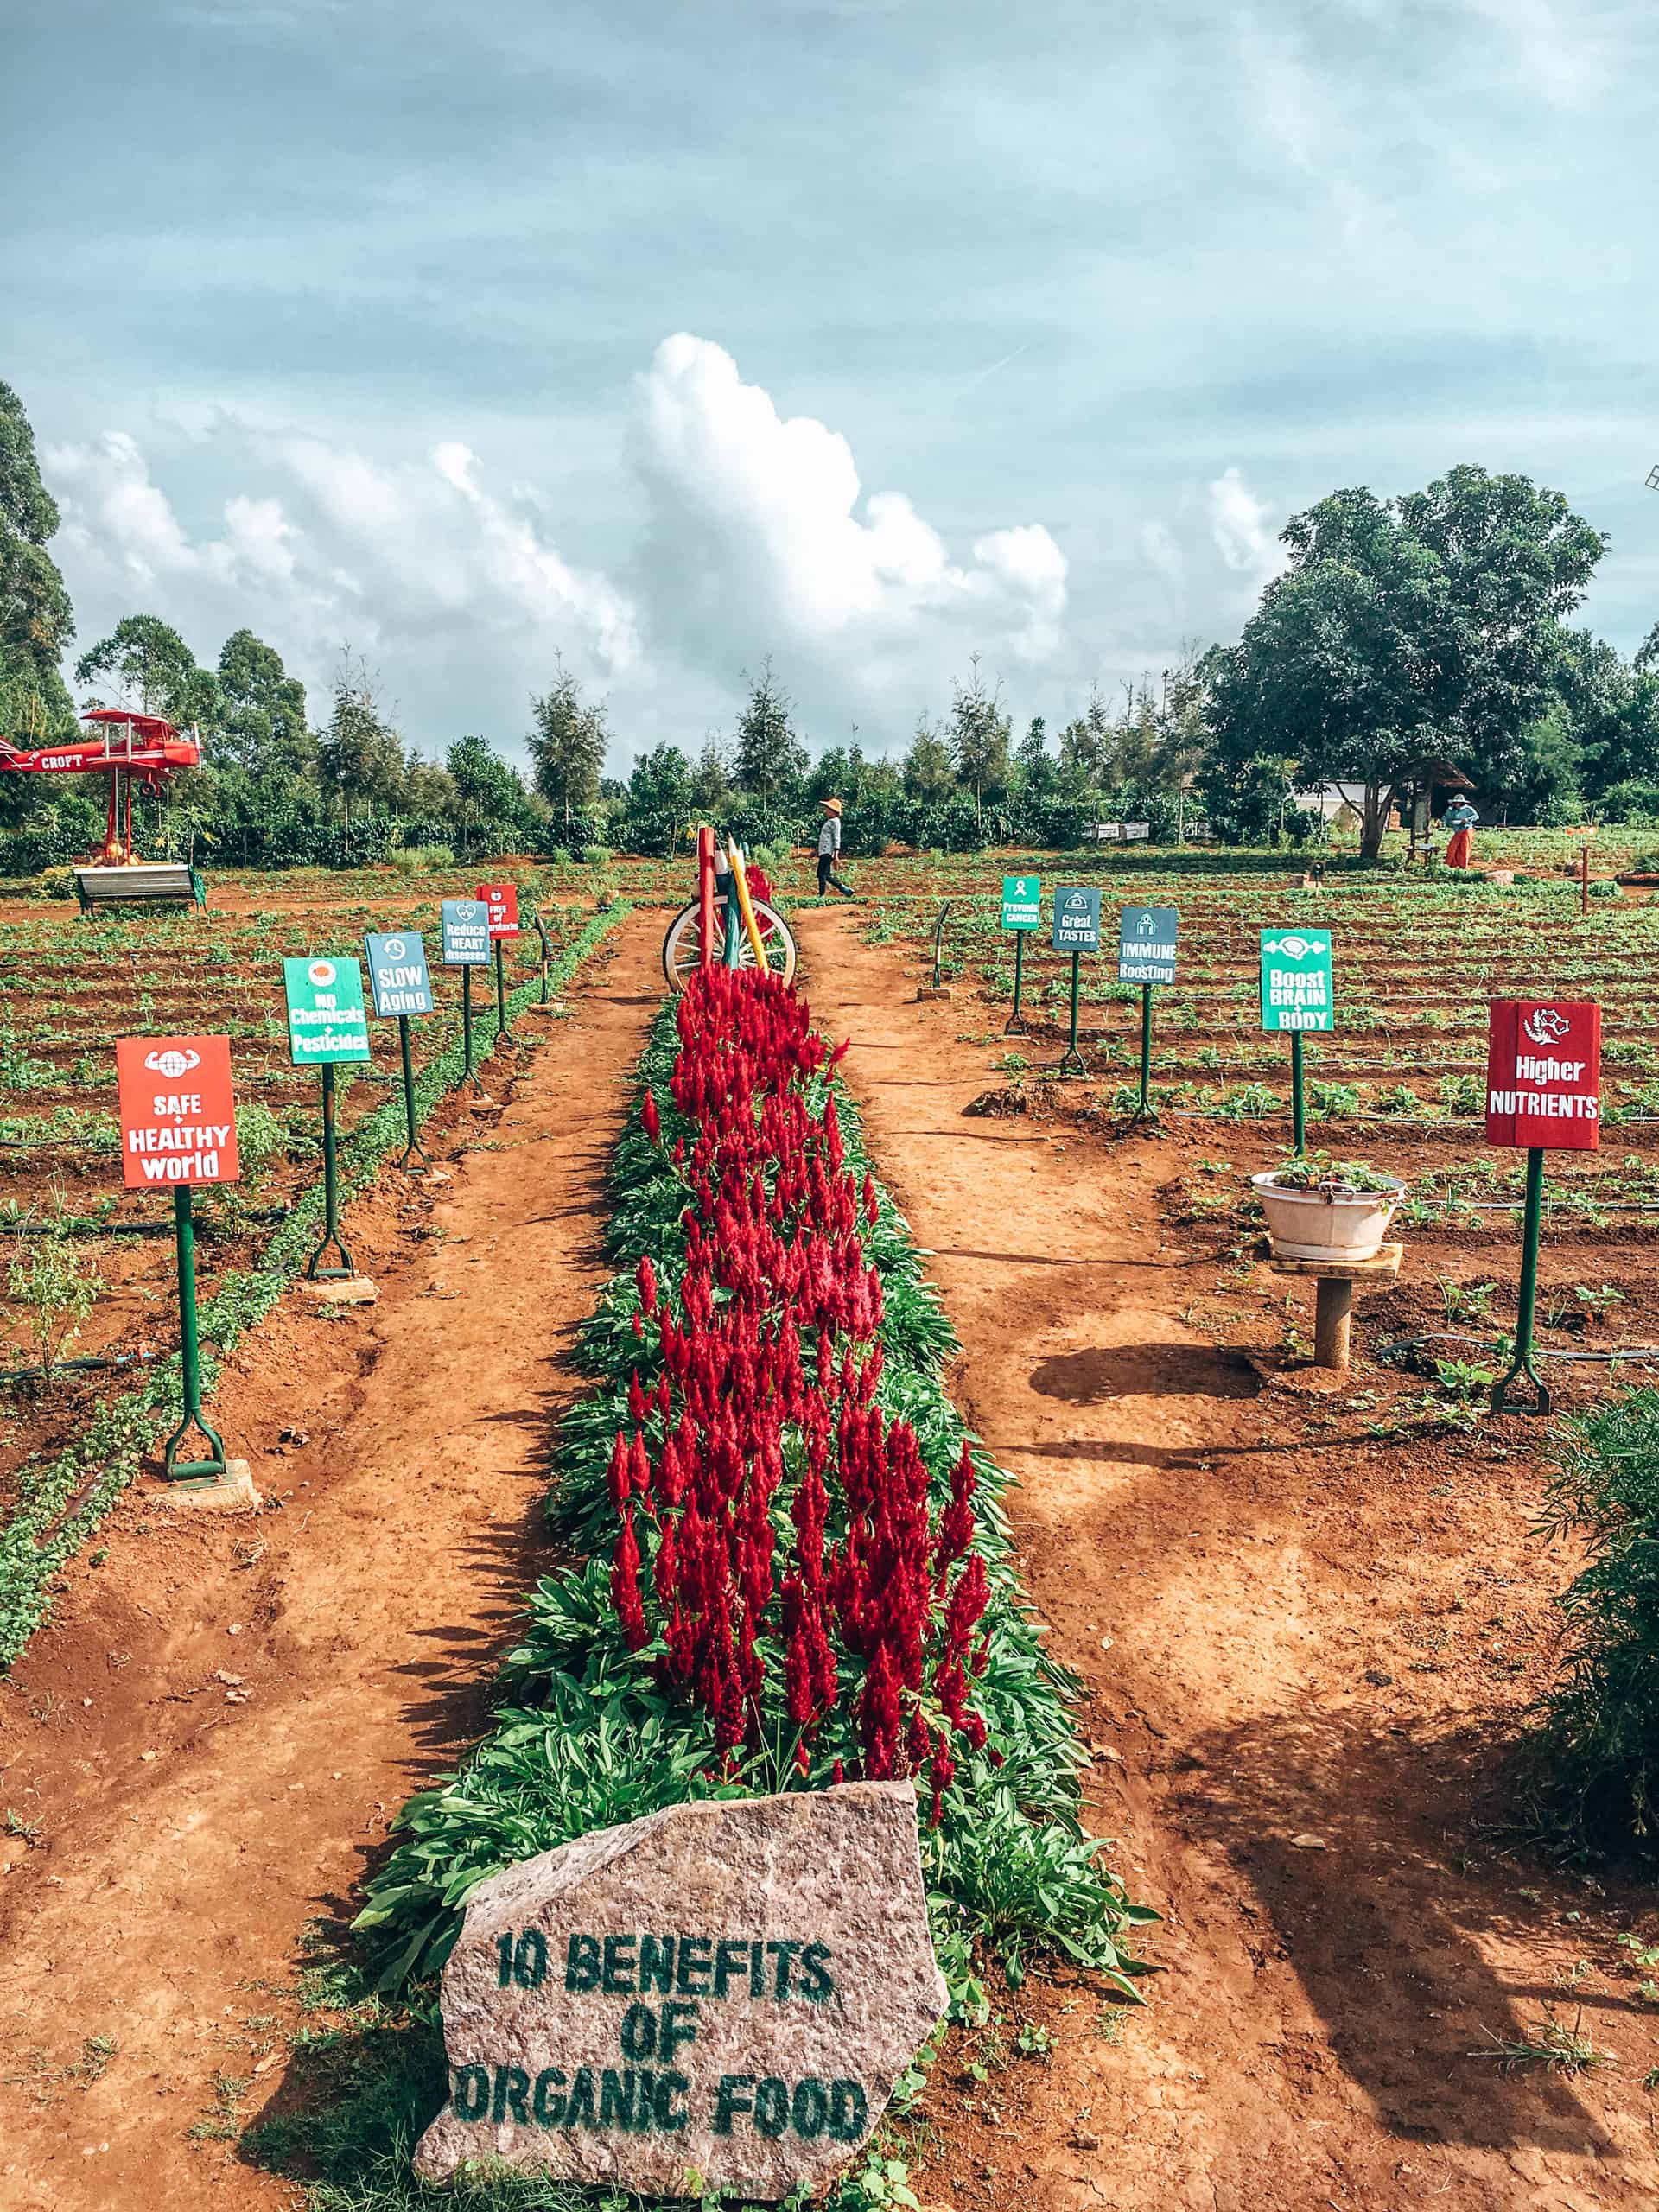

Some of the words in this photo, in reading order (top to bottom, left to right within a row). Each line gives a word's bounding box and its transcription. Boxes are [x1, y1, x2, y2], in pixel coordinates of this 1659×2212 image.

[41, 754, 83, 769] CROFT
[489, 905, 508, 913] FREE
[447, 923, 486, 936] Reduce
[1061, 914, 1092, 929] Great
[451, 938, 484, 950] HEART
[1058, 929, 1096, 943] TASTES
[445, 949, 486, 961] diseases
[1122, 942, 1176, 960] IMMUNE
[378, 966, 423, 988] SLOW
[1120, 963, 1173, 982] Boosting
[1270, 969, 1325, 988] Boost
[379, 991, 426, 1013] Aging
[1270, 988, 1326, 1006] BRAIN
[291, 1006, 366, 1025] Chemicals
[1279, 1011, 1328, 1029] BODY
[293, 1033, 369, 1052] Pesticides
[1516, 1055, 1586, 1085] Higher
[153, 1094, 202, 1116] SAFE
[1490, 1090, 1598, 1119] NUTRIENTS
[129, 1125, 231, 1153] HEALTHY
[141, 1150, 219, 1179] world
[495, 1928, 550, 1991] 10
[564, 1932, 835, 2002] BENEFITS
[620, 2000, 699, 2063] OF
[451, 2064, 691, 2133] ORGANIC
[712, 2074, 867, 2142] FOOD
